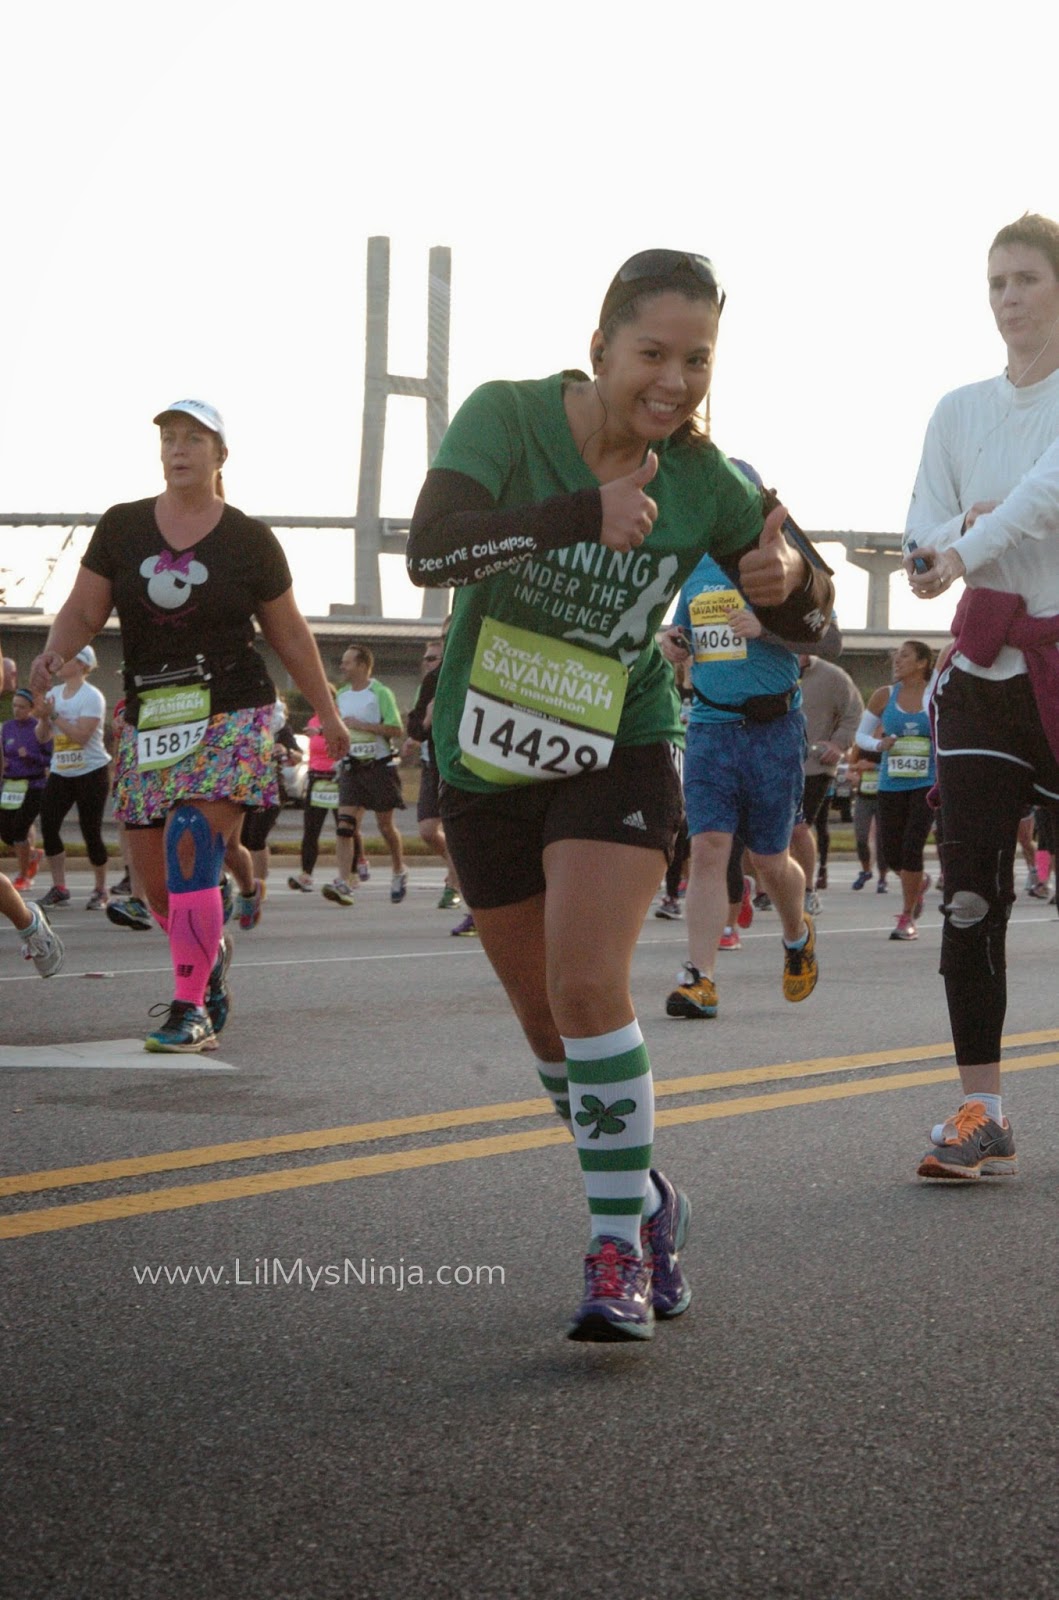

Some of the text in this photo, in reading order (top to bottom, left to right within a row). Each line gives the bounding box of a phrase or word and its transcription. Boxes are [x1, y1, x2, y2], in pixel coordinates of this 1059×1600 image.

[508, 559, 629, 611] UNDER THE
[545, 541, 652, 588] NNING
[513, 583, 613, 632] INFLUENCE
[491, 635, 545, 667] Rock
[482, 649, 613, 710] SAVANNAH
[520, 687, 586, 714] marathon
[471, 705, 599, 775] 14429
[891, 758, 927, 770] 18438
